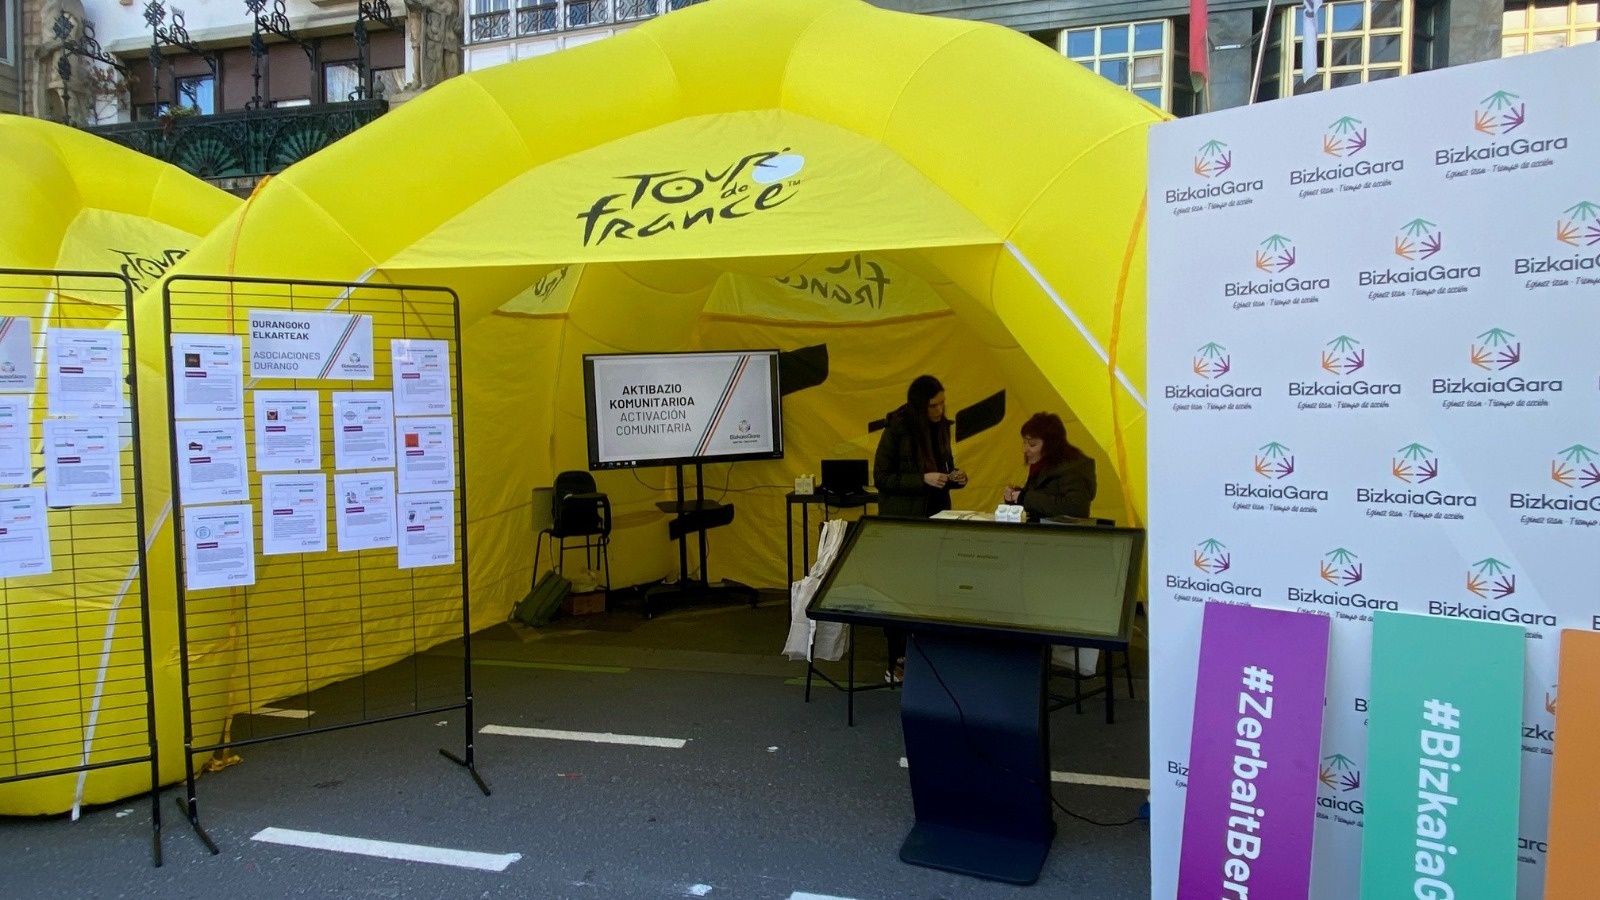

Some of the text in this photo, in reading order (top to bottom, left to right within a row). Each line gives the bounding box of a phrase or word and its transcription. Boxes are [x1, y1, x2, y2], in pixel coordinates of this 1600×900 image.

[1435, 137, 1568, 166] BizkaiaGara
[1290, 160, 1404, 185] BizkaiaGara
[1166, 180, 1263, 203] BizkaiaGara
[1359, 265, 1481, 286] BizkaiaGara
[1225, 277, 1329, 297] BizkaiaGara
[253, 320, 310, 329] DURANGOKO
[253, 331, 309, 340] ELKARTEAK
[253, 351, 320, 360] ASOCIACIONES
[622, 384, 682, 395] AKTIBAZIO
[1165, 384, 1262, 398] BizkaiaGara
[1289, 380, 1401, 396] BizkaiaGara
[1432, 377, 1562, 394] BizkaiaGara
[609, 397, 695, 409] KOMUNITARIOA
[621, 409, 686, 422] ACTIVACIÓN
[616, 423, 692, 436] COMUNITARIA
[1224, 483, 1328, 500] BizkaiaGara
[1357, 488, 1476, 506] BizkaiaGara
[1166, 575, 1261, 597] BizkaiaGara
[1288, 587, 1398, 611] BizkaiaGara
[1429, 601, 1557, 626] BizkaiaGara
[1222, 666, 1274, 900] #ZerbaitBer
[1414, 699, 1461, 900] #BizkaiaG
